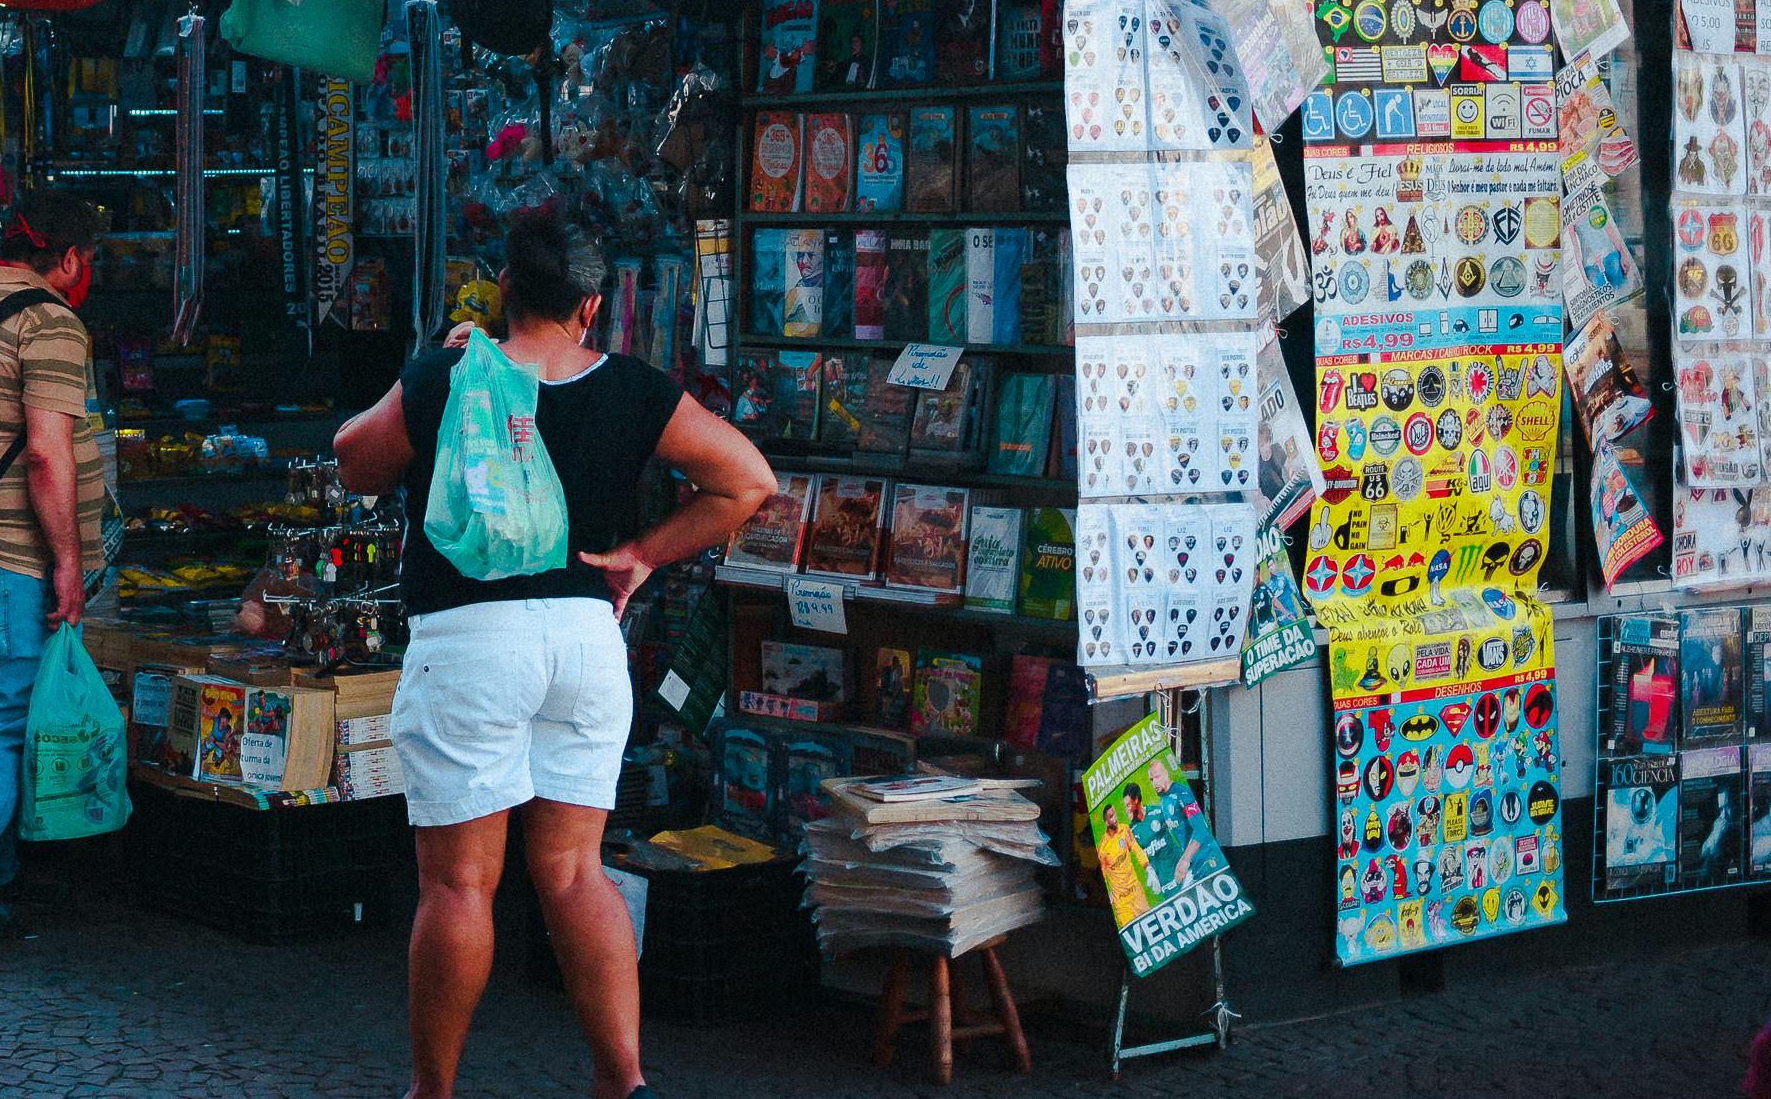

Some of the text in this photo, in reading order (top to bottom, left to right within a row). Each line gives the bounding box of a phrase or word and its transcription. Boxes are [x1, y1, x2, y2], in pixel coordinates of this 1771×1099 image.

[1701, 16, 1721, 29] 5,00
[1452, 86, 1484, 96] SORRIA
[1556, 70, 1587, 100] PIOCA
[1529, 127, 1551, 135] FUMAR
[1321, 147, 1348, 156] CORES
[1406, 142, 1455, 155] RELIGIOSOS
[1526, 143, 1557, 153] 4,99
[862, 142, 899, 174] 365
[1485, 157, 1495, 173] de
[1529, 157, 1558, 173] Amém!
[325, 78, 350, 265] ICAMPEÃO
[1308, 164, 1343, 181] Deus
[1357, 163, 1392, 184] Fiel
[1565, 163, 1587, 184] FIM DO
[1397, 179, 1424, 191] JESUS
[1451, 180, 1470, 194] Senhor
[1475, 182, 1488, 193] meu
[1489, 180, 1507, 196] pastor
[1513, 179, 1527, 193] nada
[1527, 182, 1536, 193] me
[1317, 184, 1337, 200] Deus
[1338, 190, 1359, 203] quem
[1360, 189, 1372, 198] me
[1562, 180, 1598, 218] OMETRIOSE
[1576, 191, 1603, 217] CISTITE
[279, 175, 296, 293] LIBERTADORES
[318, 263, 334, 304] 2015
[1573, 292, 1616, 324] TRATAMENTOS
[1342, 312, 1414, 327] ADESIVOS
[1342, 338, 1362, 350] R$
[1363, 333, 1414, 351] 4,99
[1524, 343, 1556, 354] 4,99
[907, 343, 949, 360] Promoção
[1334, 355, 1358, 365] CORES
[1346, 388, 1377, 409] BEATLES
[1521, 416, 1550, 426] SHELL
[1365, 465, 1385, 473] ROUTE
[1365, 483, 1385, 499] 66
[1353, 509, 1362, 518] NO
[1351, 520, 1368, 528] PAIN
[1350, 532, 1360, 540] NO
[1613, 517, 1652, 551] GORDURA
[1038, 543, 1074, 556] CÉREBRO
[1350, 542, 1366, 550] GAIN
[1614, 526, 1657, 561] COLESTEROL
[1675, 533, 1697, 552] CHORA
[1035, 555, 1073, 571] ATIVO
[1428, 562, 1449, 573] NASA
[1676, 556, 1695, 576] BOY
[1329, 625, 1353, 643] Deus
[1357, 623, 1389, 643] abençoe
[1246, 623, 1305, 668] O TIME DA
[1416, 649, 1434, 658] PELA
[1482, 640, 1505, 666] VANS
[1244, 640, 1317, 686] SUPERAÇÃO
[1416, 658, 1451, 669] CADA UM
[1434, 681, 1483, 698] DESENHOS
[1525, 670, 1548, 682] 4,99
[1333, 696, 1378, 710] DUAS CORES
[1692, 705, 1735, 717] ABERTURA PARA
[242, 736, 273, 749] Oferta de
[241, 753, 271, 765] turma da
[1086, 719, 1164, 800] PALMEIRAS
[1612, 763, 1634, 786] 160
[1445, 818, 1464, 826] PLEASE
[1445, 828, 1464, 839] FORCE
[1121, 873, 1239, 955] VERDÃO
[1133, 951, 1154, 974] BI
[1152, 940, 1179, 966] DA
